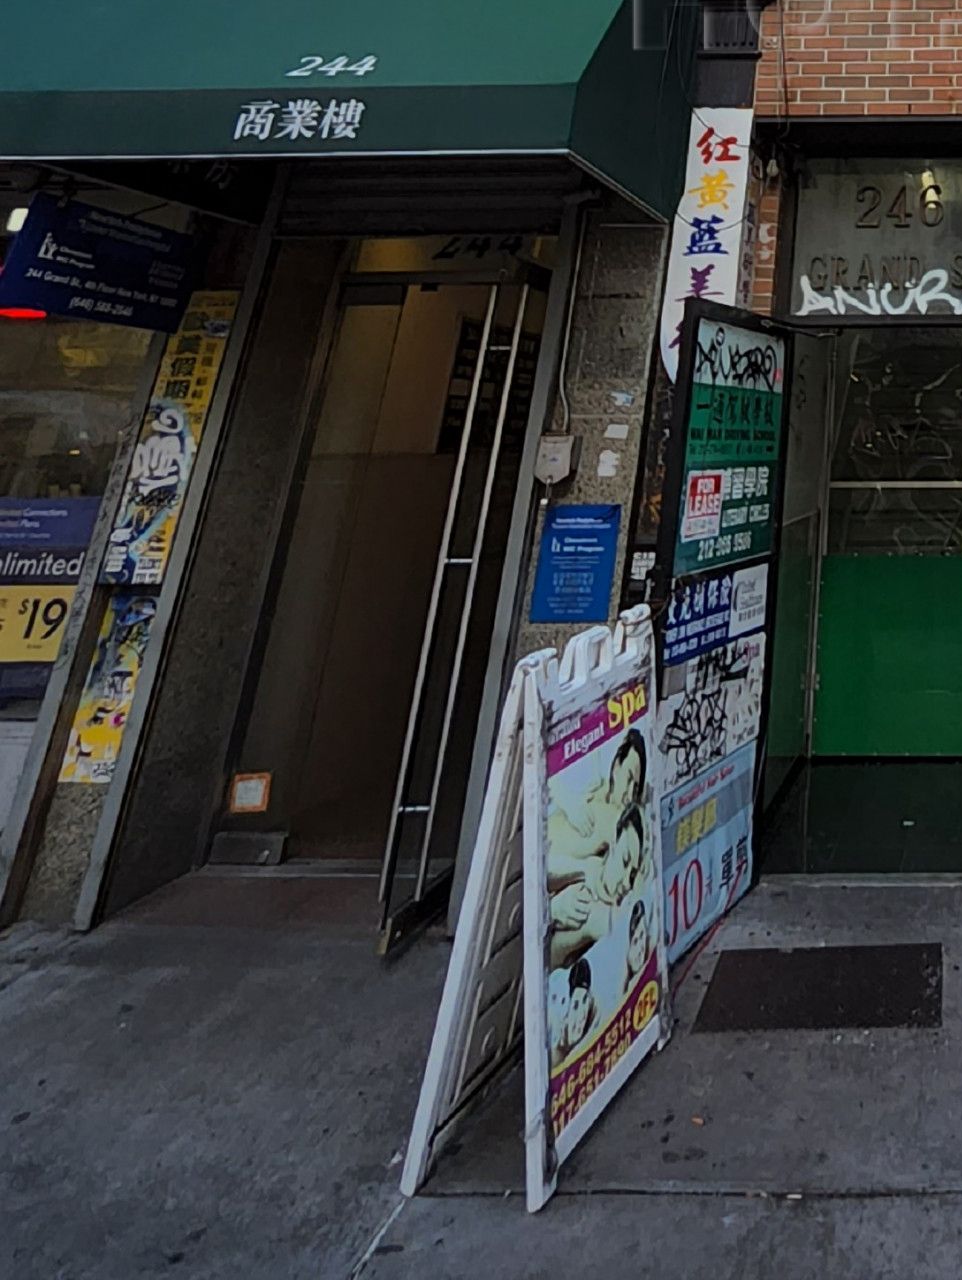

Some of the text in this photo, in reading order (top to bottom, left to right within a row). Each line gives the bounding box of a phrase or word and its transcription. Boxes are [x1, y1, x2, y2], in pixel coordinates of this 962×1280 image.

[285, 53, 380, 78] 244
[233, 99, 366, 141] 商業樓
[855, 184, 945, 229] 246
[688, 492, 720, 517] LEASE
[0, 550, 86, 577] limited
[563, 683, 646, 762] Elegant Spa
